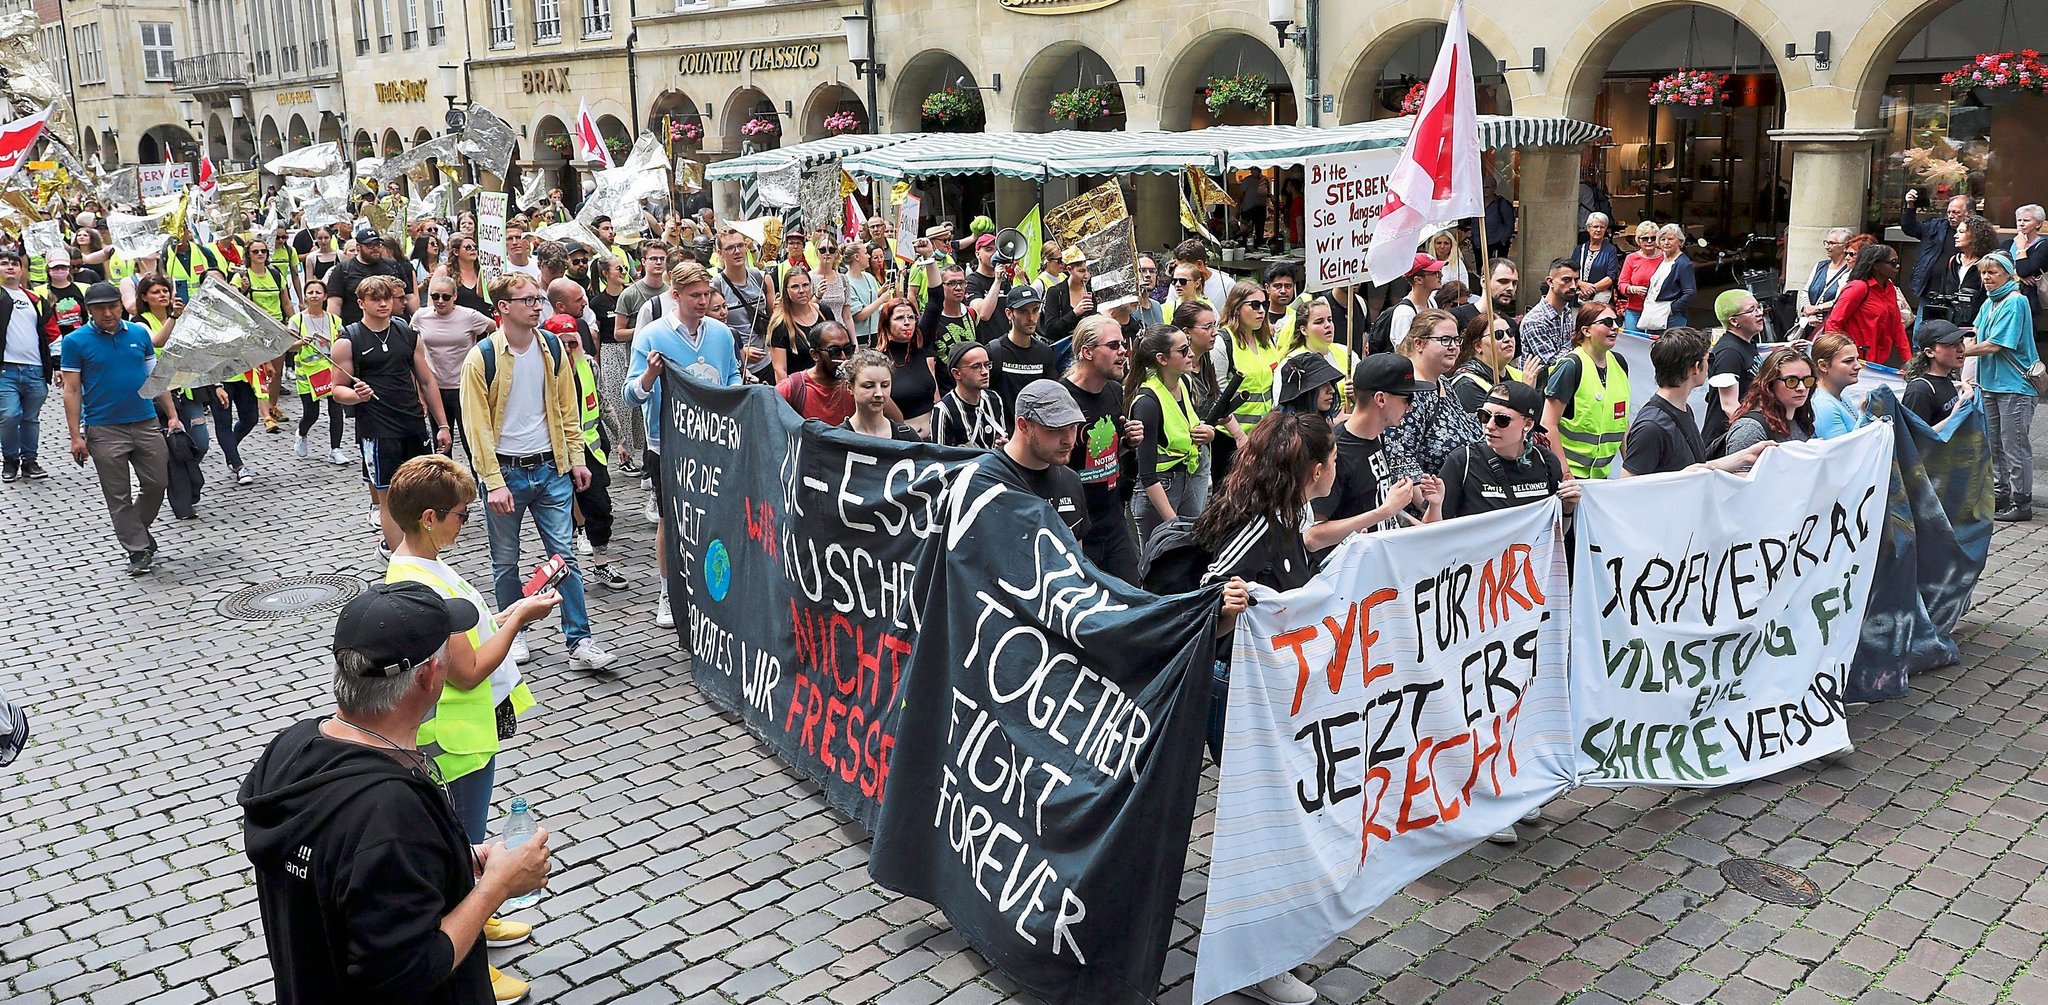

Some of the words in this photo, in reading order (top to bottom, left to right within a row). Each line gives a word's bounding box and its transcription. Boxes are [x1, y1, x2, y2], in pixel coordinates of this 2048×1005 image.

[520, 66, 572, 94] BRAX
[677, 50, 745, 75] COUNTRY
[748, 43, 820, 72] CLASSICS
[139, 167, 189, 184] ERVICE
[1311, 163, 1348, 184] Bitte
[1325, 174, 1389, 206] STERBEN
[1313, 209, 1336, 228] Sie
[1316, 233, 1343, 254] wir
[1319, 254, 1357, 281] Keine
[671, 397, 742, 450] VERÄNDERN
[700, 464, 722, 497] DIE
[673, 496, 706, 546] WELT
[744, 495, 778, 565] WIR
[998, 528, 1128, 648] STAY
[1414, 563, 1474, 664] FÜR
[790, 596, 912, 713] NICHT
[741, 640, 781, 722] WIR
[963, 590, 1152, 783] TOGETHER
[784, 672, 896, 805] FRESSE
[947, 686, 1072, 836] FIGHT
[1360, 680, 1528, 868] RECHT
[284, 861, 308, 880] and
[933, 764, 1087, 966] FOREVER
